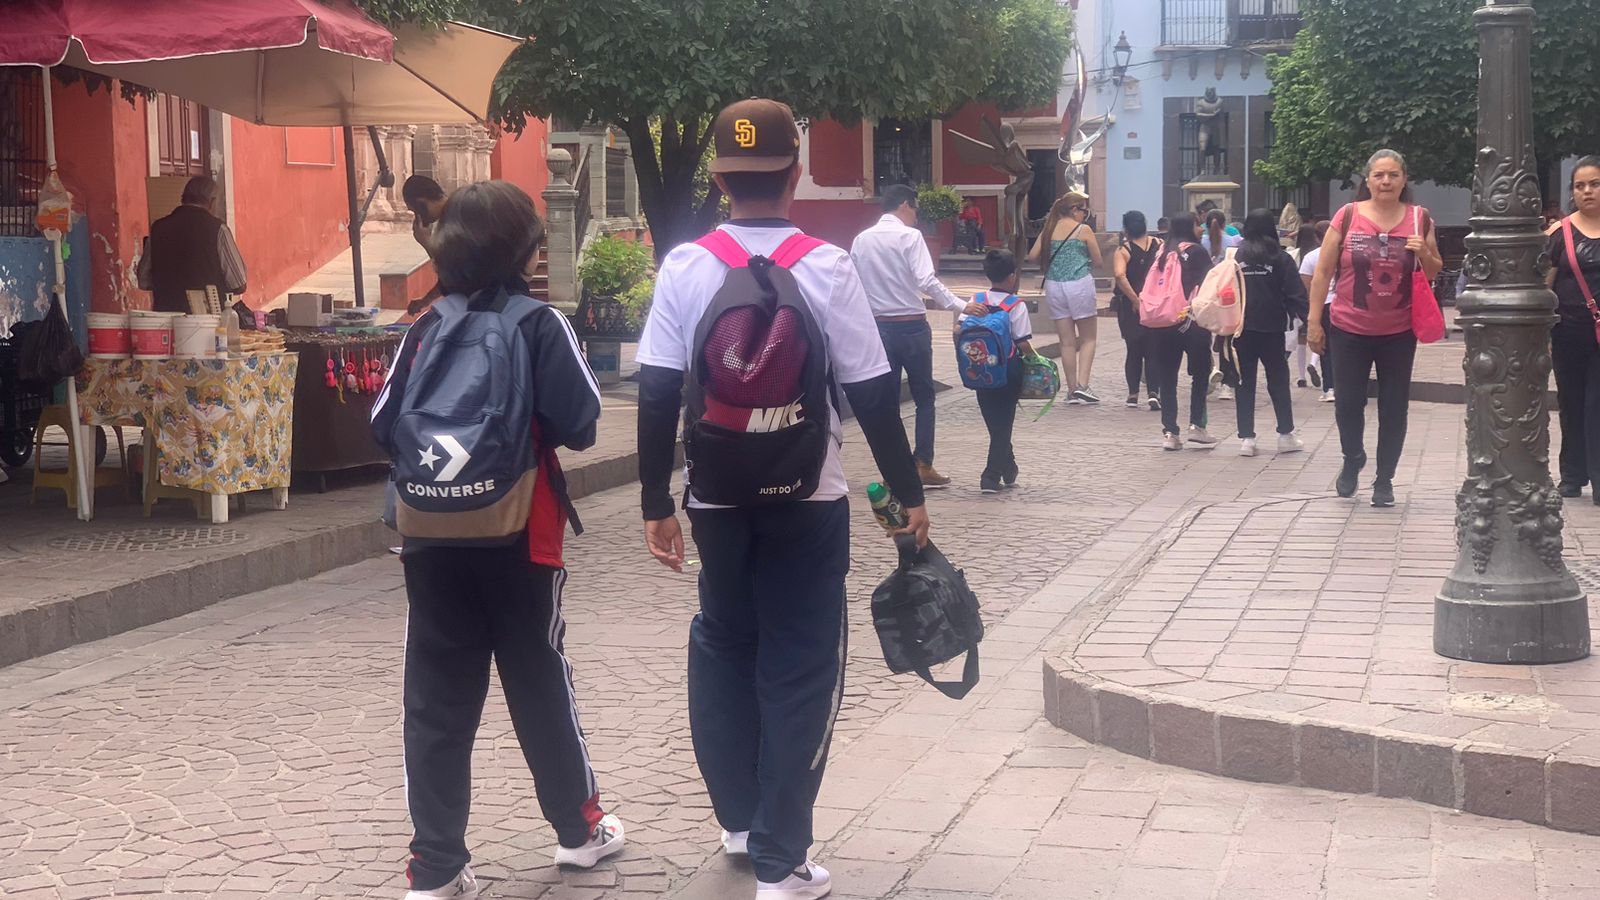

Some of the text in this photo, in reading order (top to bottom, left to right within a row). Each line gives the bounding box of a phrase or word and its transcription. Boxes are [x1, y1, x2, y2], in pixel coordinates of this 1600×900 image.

[735, 119, 755, 147] SD
[406, 479, 495, 498] CONVERSE
[759, 487, 777, 495] JUST
[779, 485, 791, 494] DO
